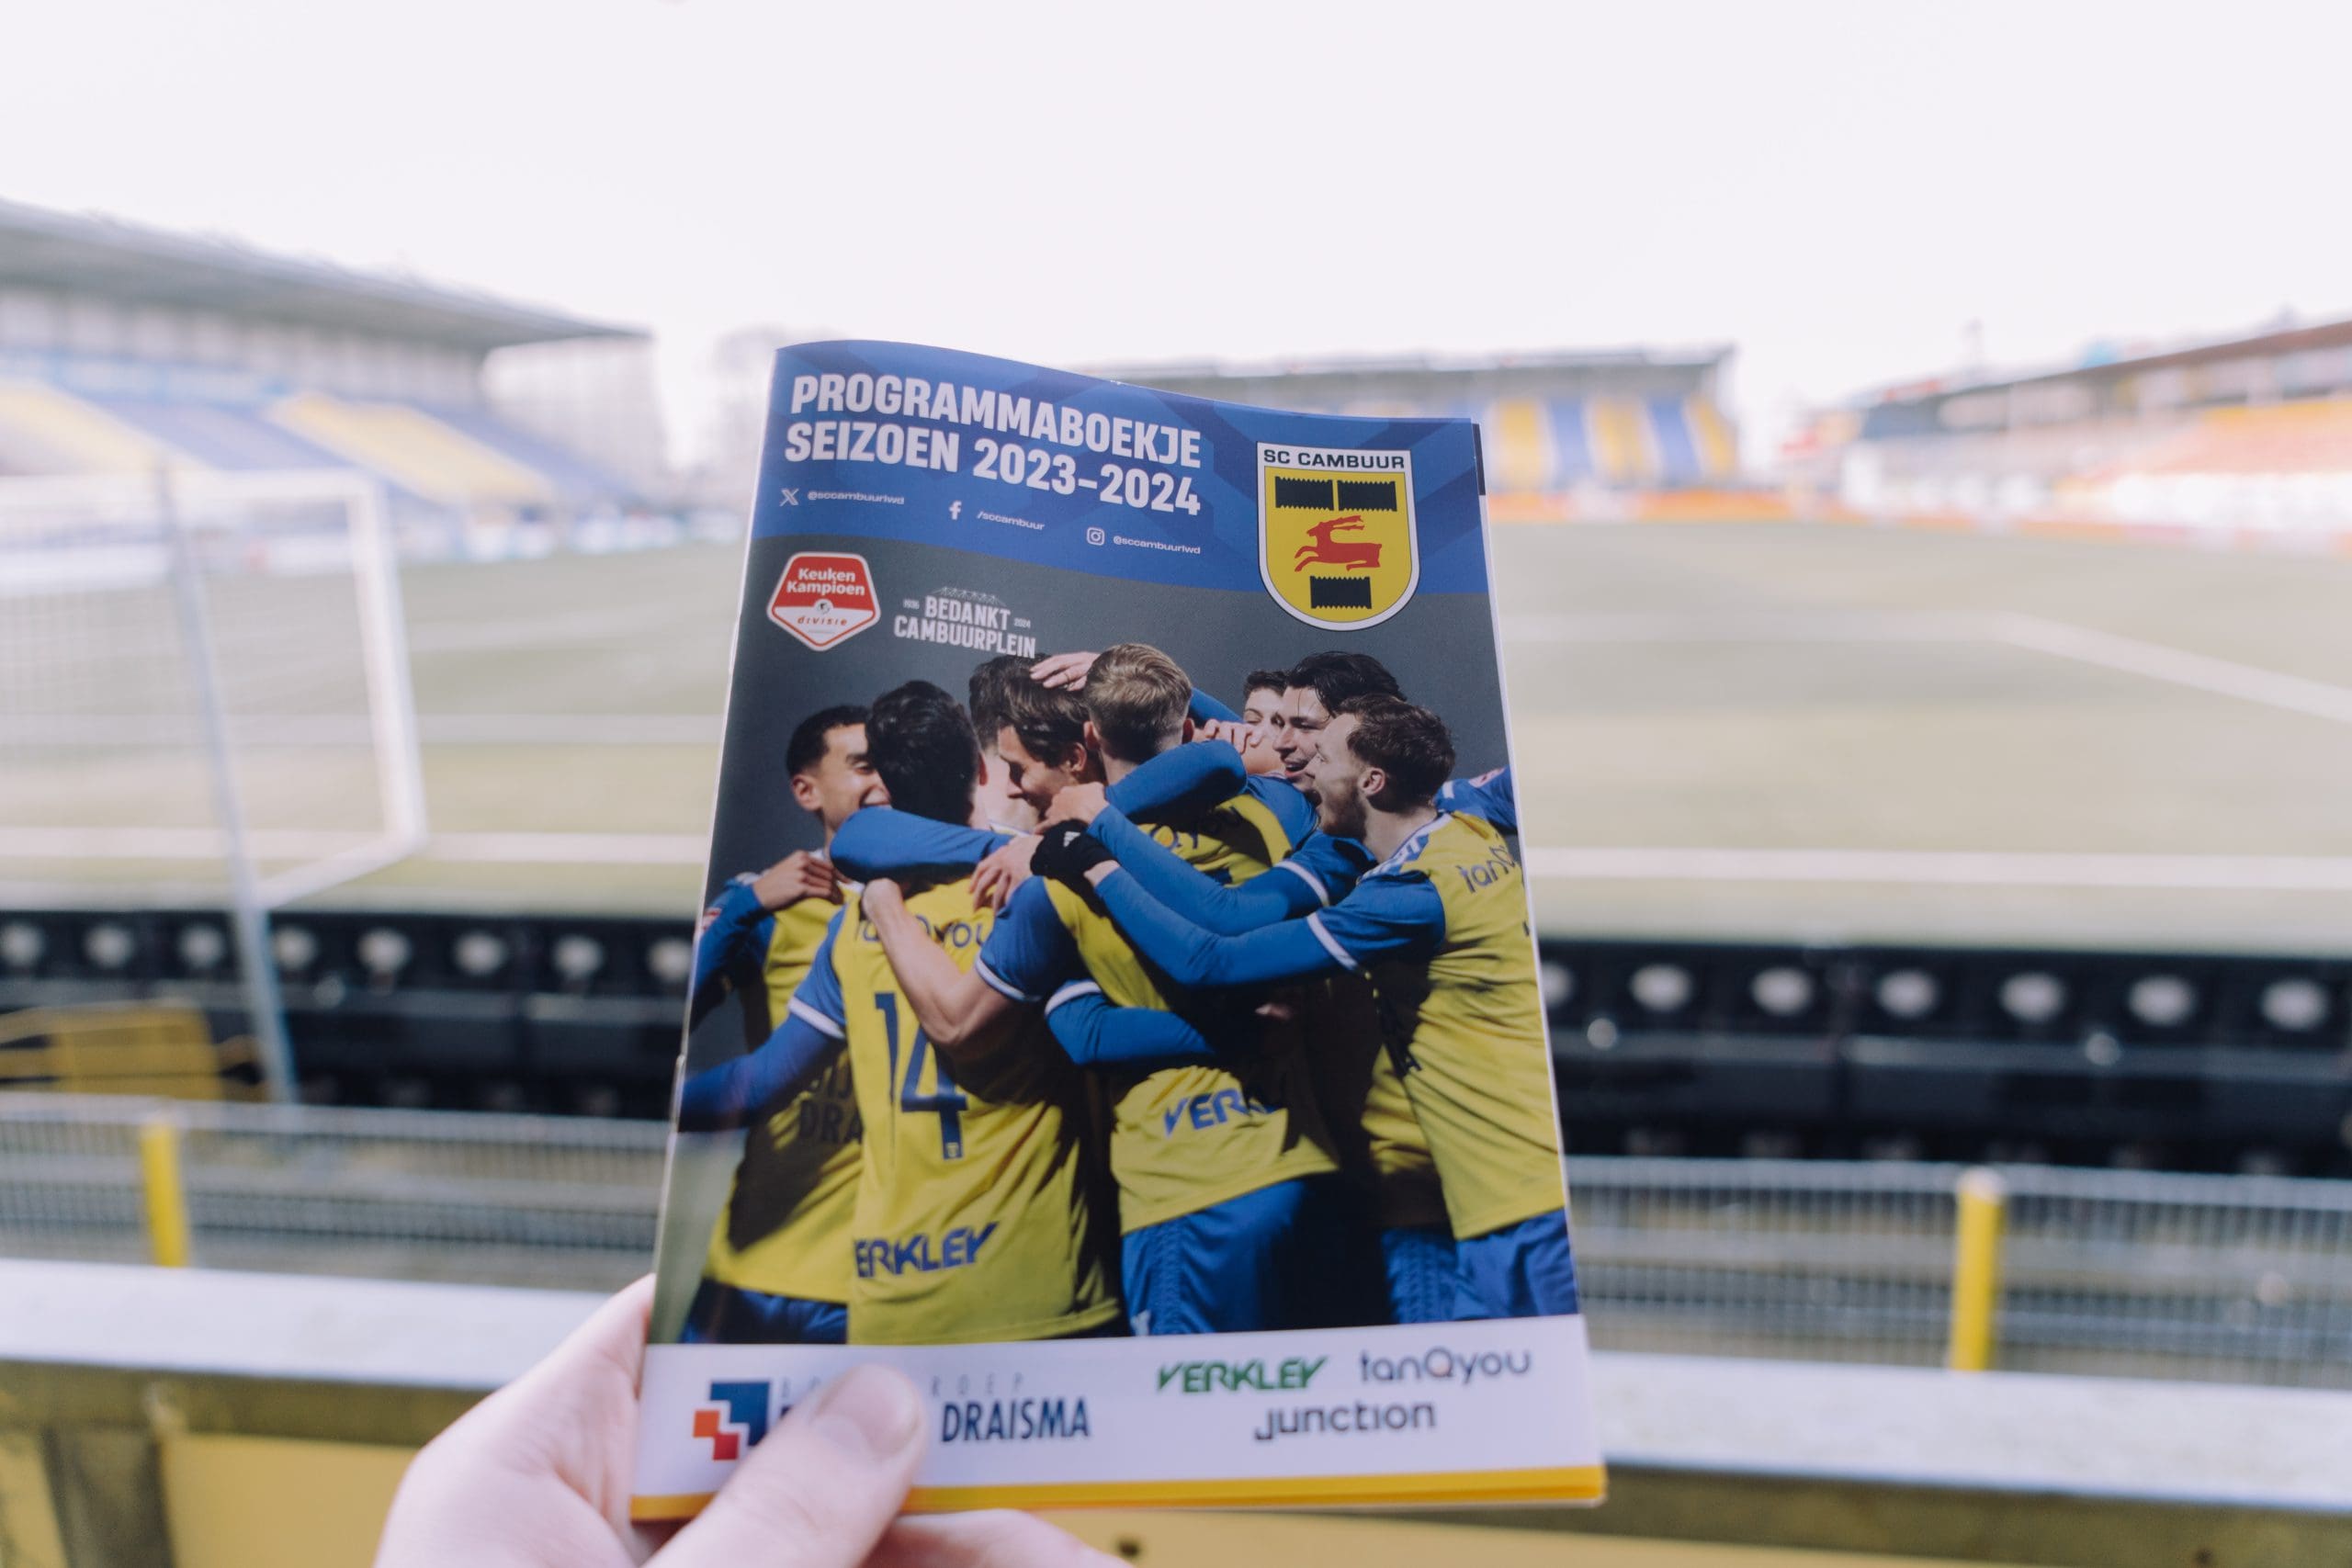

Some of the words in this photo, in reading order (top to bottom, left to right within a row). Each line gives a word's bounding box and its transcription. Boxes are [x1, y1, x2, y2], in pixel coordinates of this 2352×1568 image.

[790, 373, 1202, 468] PROGRAMMABOEKJE
[784, 421, 959, 472] SEIZOEN
[972, 438, 1201, 516] 2023-2024
[1263, 449, 1290, 464] SC
[1298, 452, 1405, 469] CAMBUUR
[807, 491, 905, 505] @sccambuurlwd
[1113, 535, 1201, 555] @sccambuurlwd
[786, 581, 865, 596] Kampioen
[798, 568, 855, 582] Keuken
[924, 595, 1011, 631] BEDANKT
[893, 615, 1036, 659] CAMBUURPLEIN
[874, 991, 968, 1161] 14
[854, 1221, 999, 1279] ERKLEY
[1157, 1354, 1329, 1393] VERKLEY
[1360, 1346, 1532, 1385] tanQyou
[941, 1395, 1091, 1443] DRAISMA
[1254, 1400, 1436, 1441] junction
